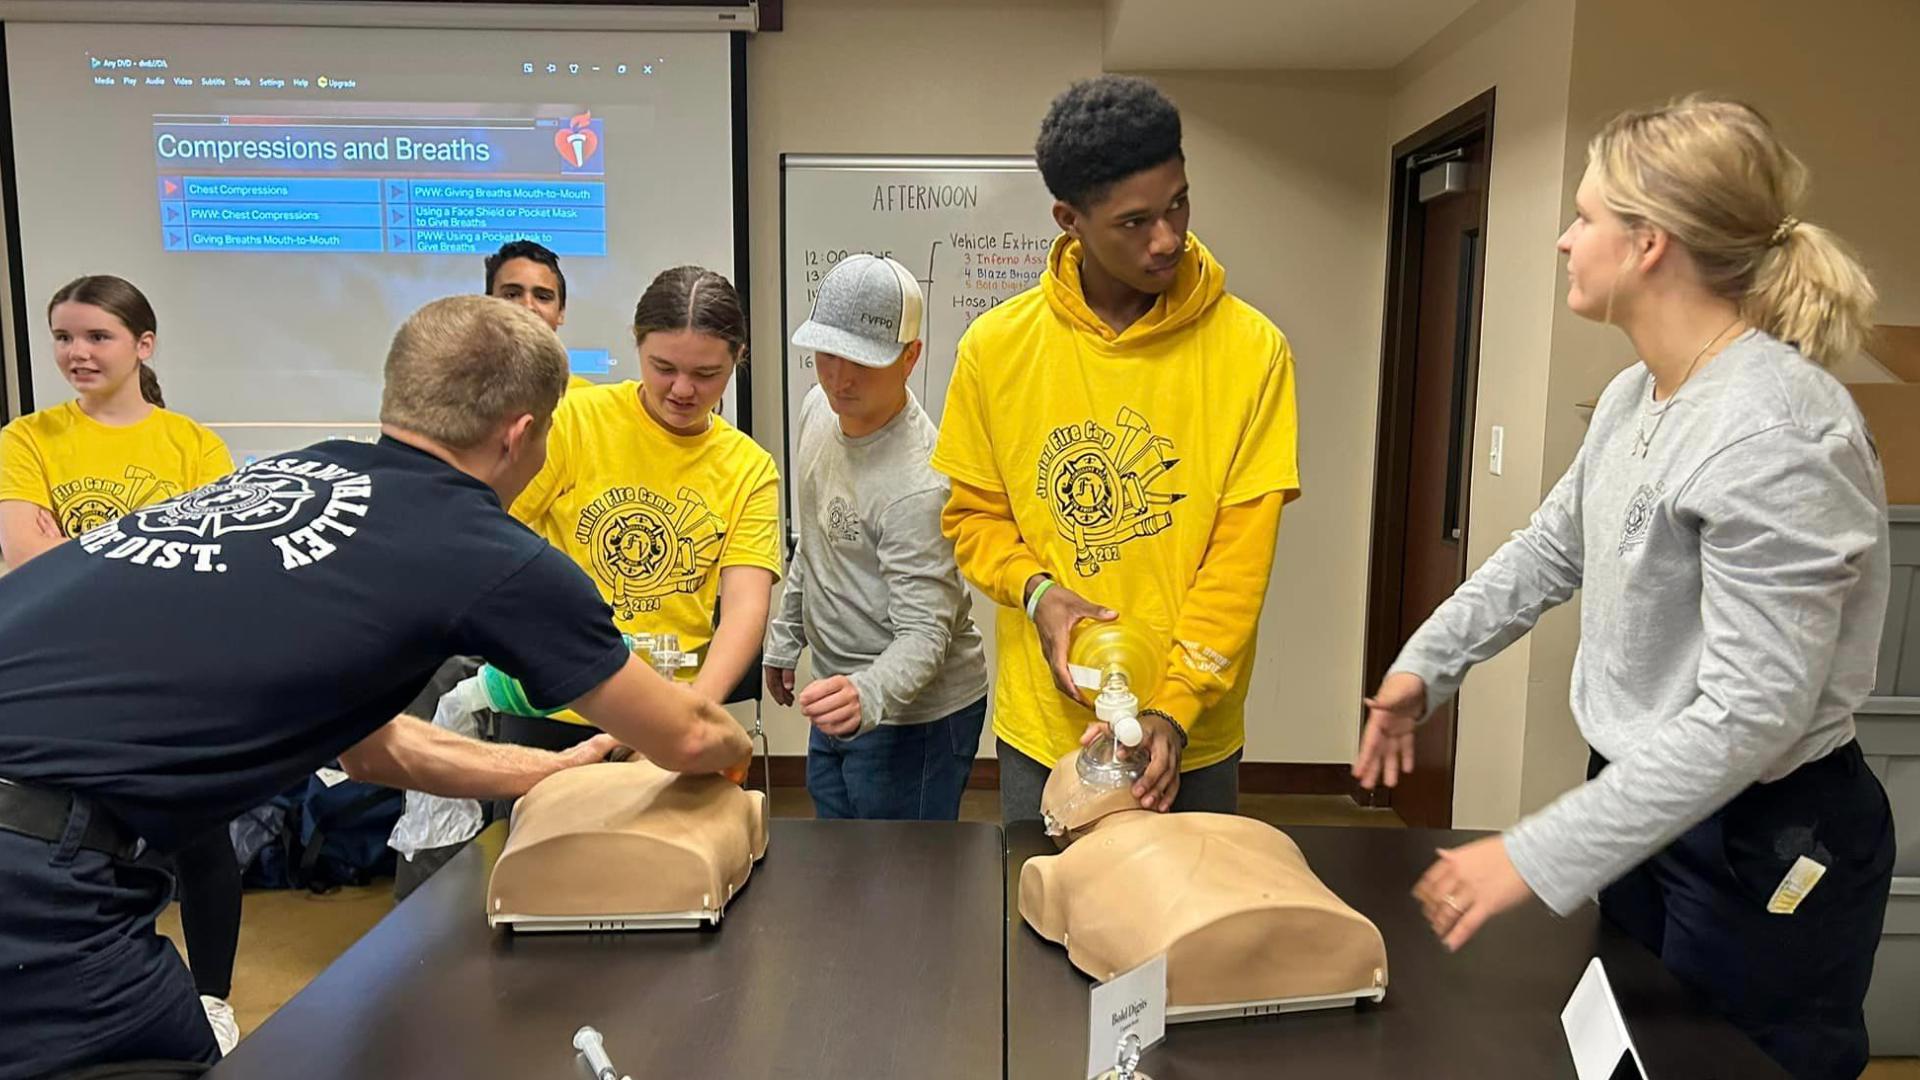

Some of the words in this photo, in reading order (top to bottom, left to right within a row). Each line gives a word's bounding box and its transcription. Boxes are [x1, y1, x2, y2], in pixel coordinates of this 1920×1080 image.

[94, 77, 115, 86] Media
[123, 77, 137, 87] Play
[145, 77, 165, 86] Audio
[173, 77, 193, 86] Video
[201, 77, 225, 87] Subtitle
[234, 78, 251, 86] Tools
[259, 78, 285, 88] Settings
[293, 79, 309, 88] Help
[328, 79, 356, 90] Upgrade
[157, 134, 337, 163] Compressions
[343, 137, 388, 161] and
[396, 137, 490, 161] Breaths
[189, 184, 218, 195] Chest
[219, 184, 288, 196] Compressions
[444, 187, 474, 199] Giving
[475, 188, 512, 199] Breaths
[513, 188, 591, 200] Mouth-to-Mouth
[872, 184, 977, 212] AFTERNOON
[221, 209, 250, 220] Chest
[251, 210, 319, 221] Compressions
[415, 206, 442, 217] Using
[451, 206, 475, 217] Face
[476, 206, 505, 217] Shield
[506, 209, 516, 217] or
[518, 208, 550, 218] Pocket
[552, 209, 578, 218] Mask
[416, 218, 426, 227] to
[428, 217, 449, 227] Give
[450, 218, 487, 228] Breaths
[193, 234, 223, 246] Giving
[224, 235, 262, 246] Breaths
[263, 235, 340, 247] Mouth-to-Mouth
[446, 231, 473, 243] Using
[482, 232, 514, 242] Pocket
[542, 233, 552, 242] to
[950, 232, 997, 249] Vehicle
[417, 242, 438, 252] Give
[440, 242, 476, 252] Breaths
[964, 252, 971, 265] 3
[976, 252, 1020, 266] Inferno
[964, 268, 971, 279] 4
[977, 268, 1008, 279] Blaze
[952, 295, 986, 308] Hose
[1048, 425, 1081, 451] Fire
[84, 476, 125, 498] Camp
[271, 474, 371, 570] VALLEY
[575, 499, 606, 545] Junior
[603, 486, 635, 508] Fire
[638, 486, 677, 515] Camp
[104, 536, 228, 573] DIST.
[631, 597, 660, 612] 2024
